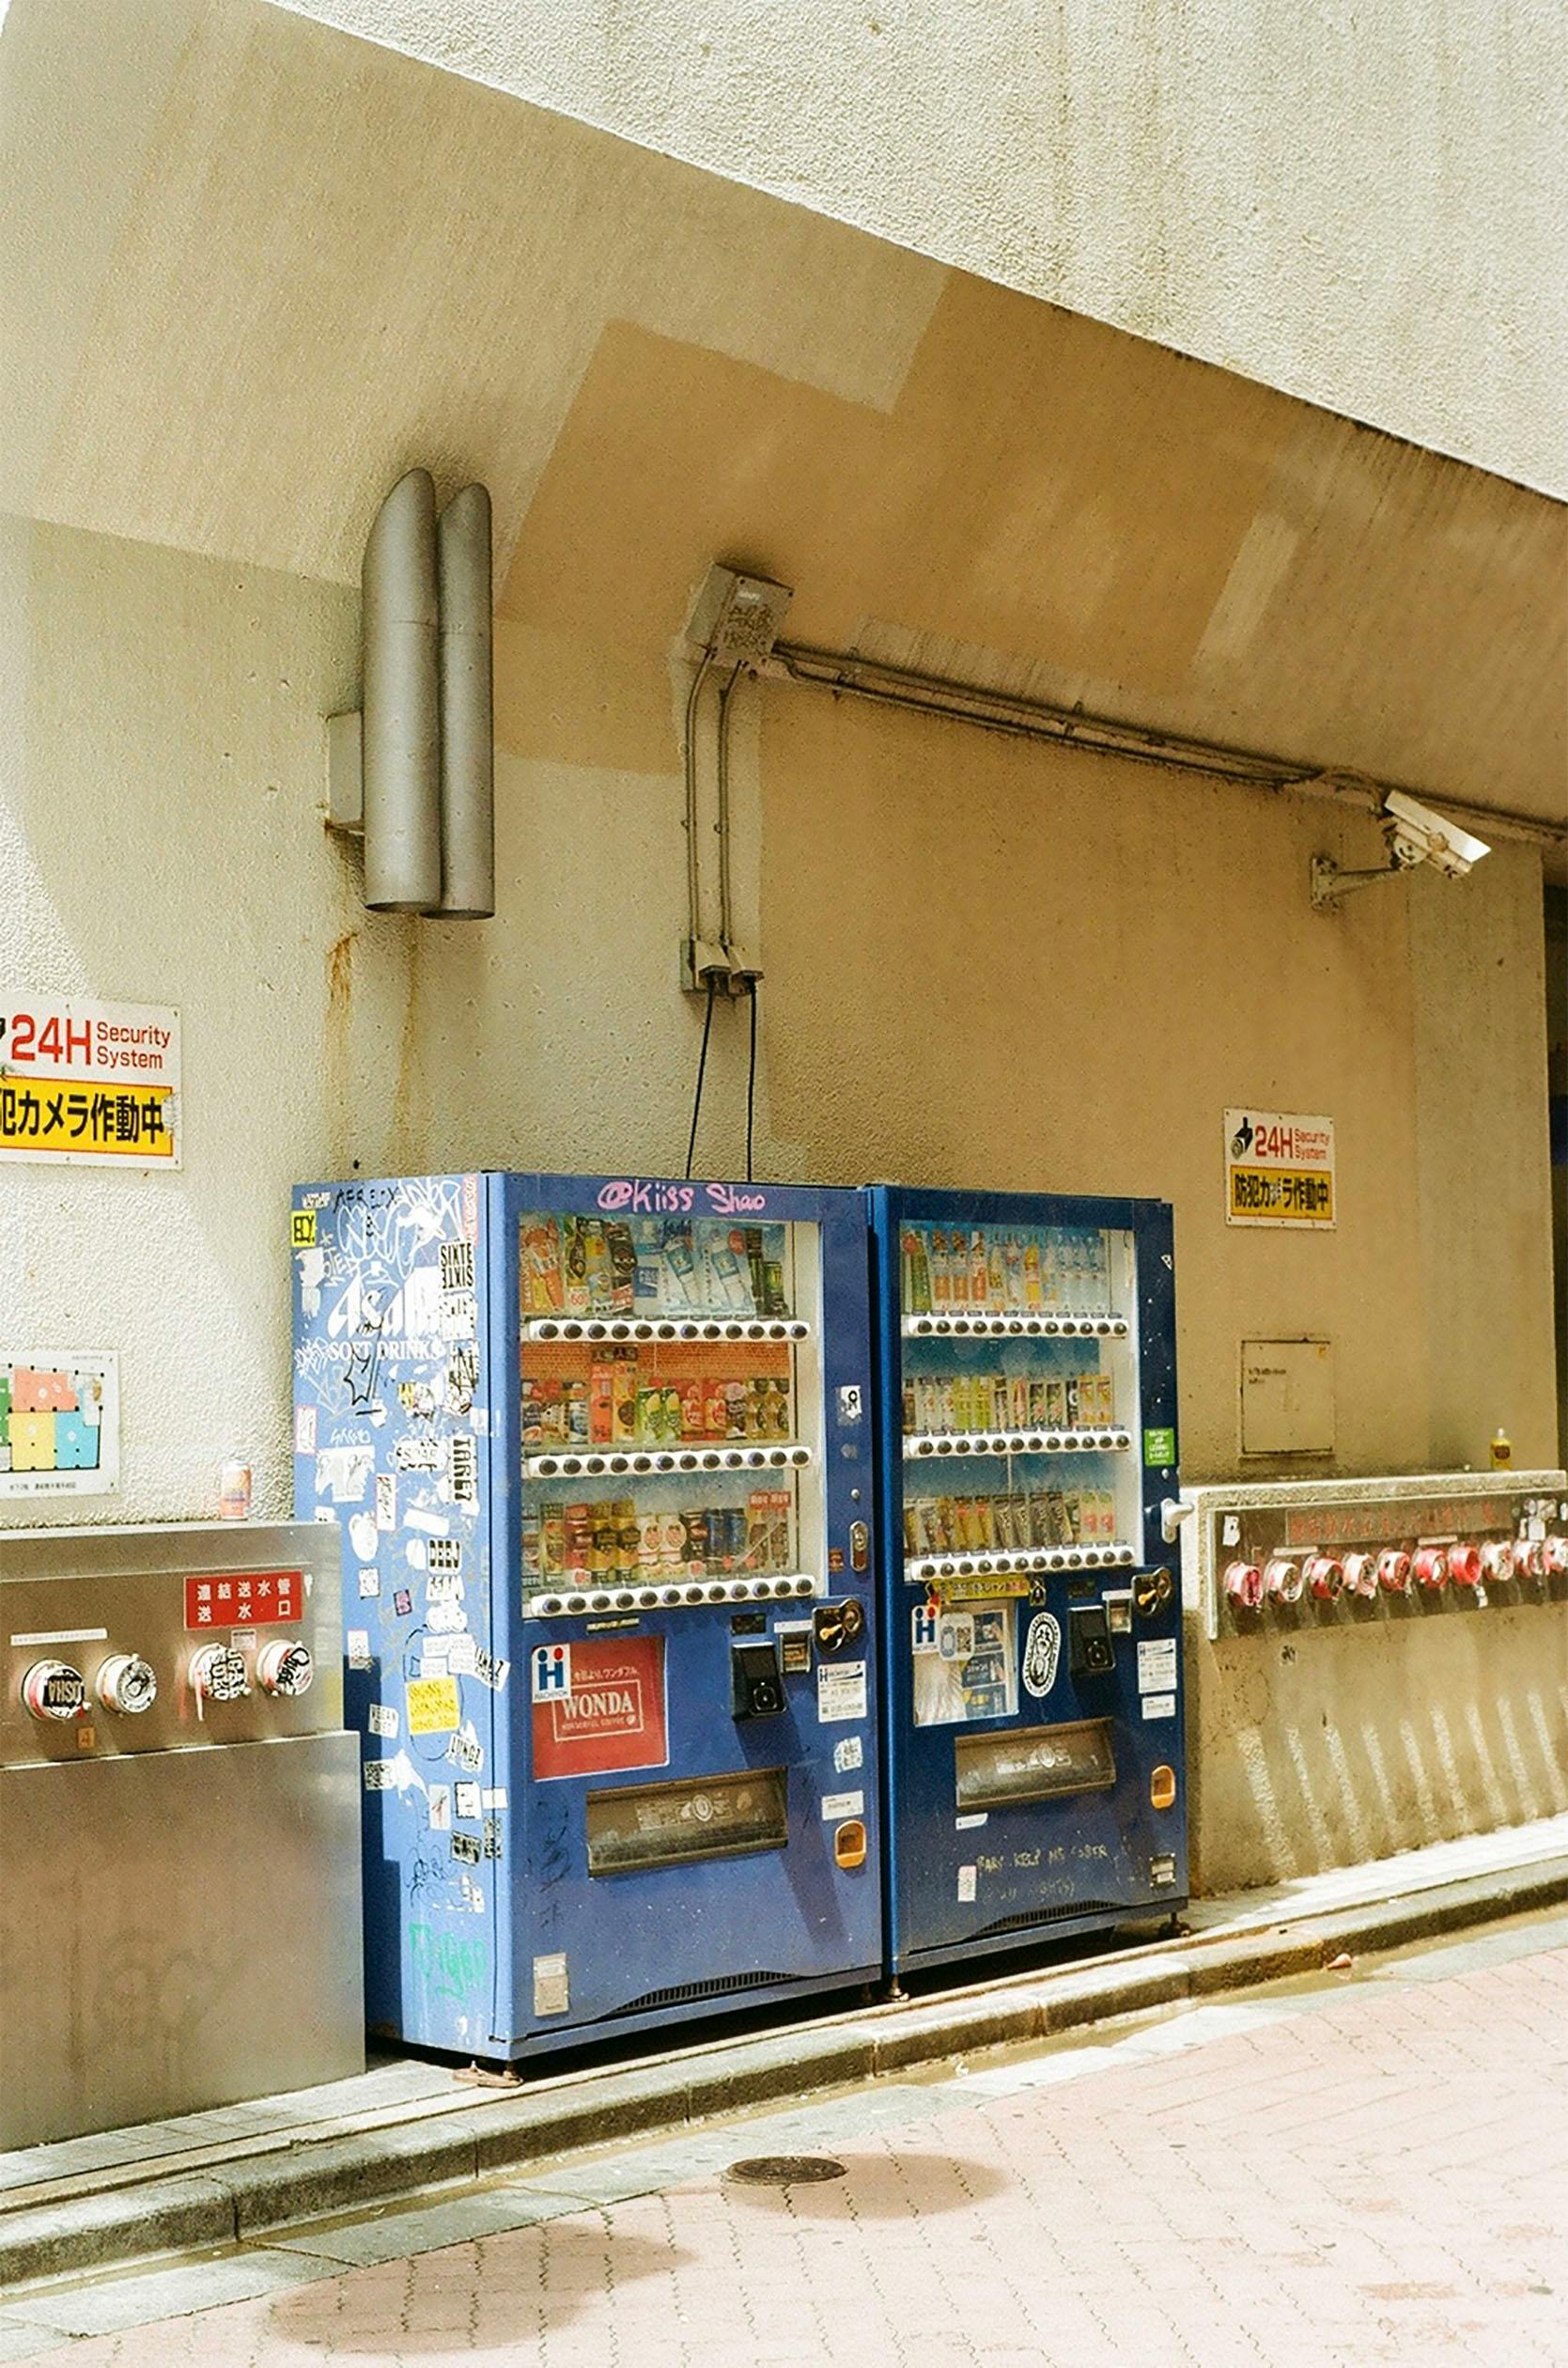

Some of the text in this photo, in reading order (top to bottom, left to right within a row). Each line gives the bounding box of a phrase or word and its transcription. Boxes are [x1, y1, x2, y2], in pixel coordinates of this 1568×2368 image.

[11, 1014, 171, 1066] 24H Security
[97, 1046, 163, 1068] System
[1255, 1125, 1330, 1158] 24H Security
[1295, 1145, 1326, 1161] System
[441, 1242, 473, 1267] SIXTE
[329, 1340, 372, 1360] SOFT
[197, 1579, 290, 1601] 連結送水管
[197, 1599, 291, 1623] 送水口
[562, 1690, 635, 1720] WONDA
